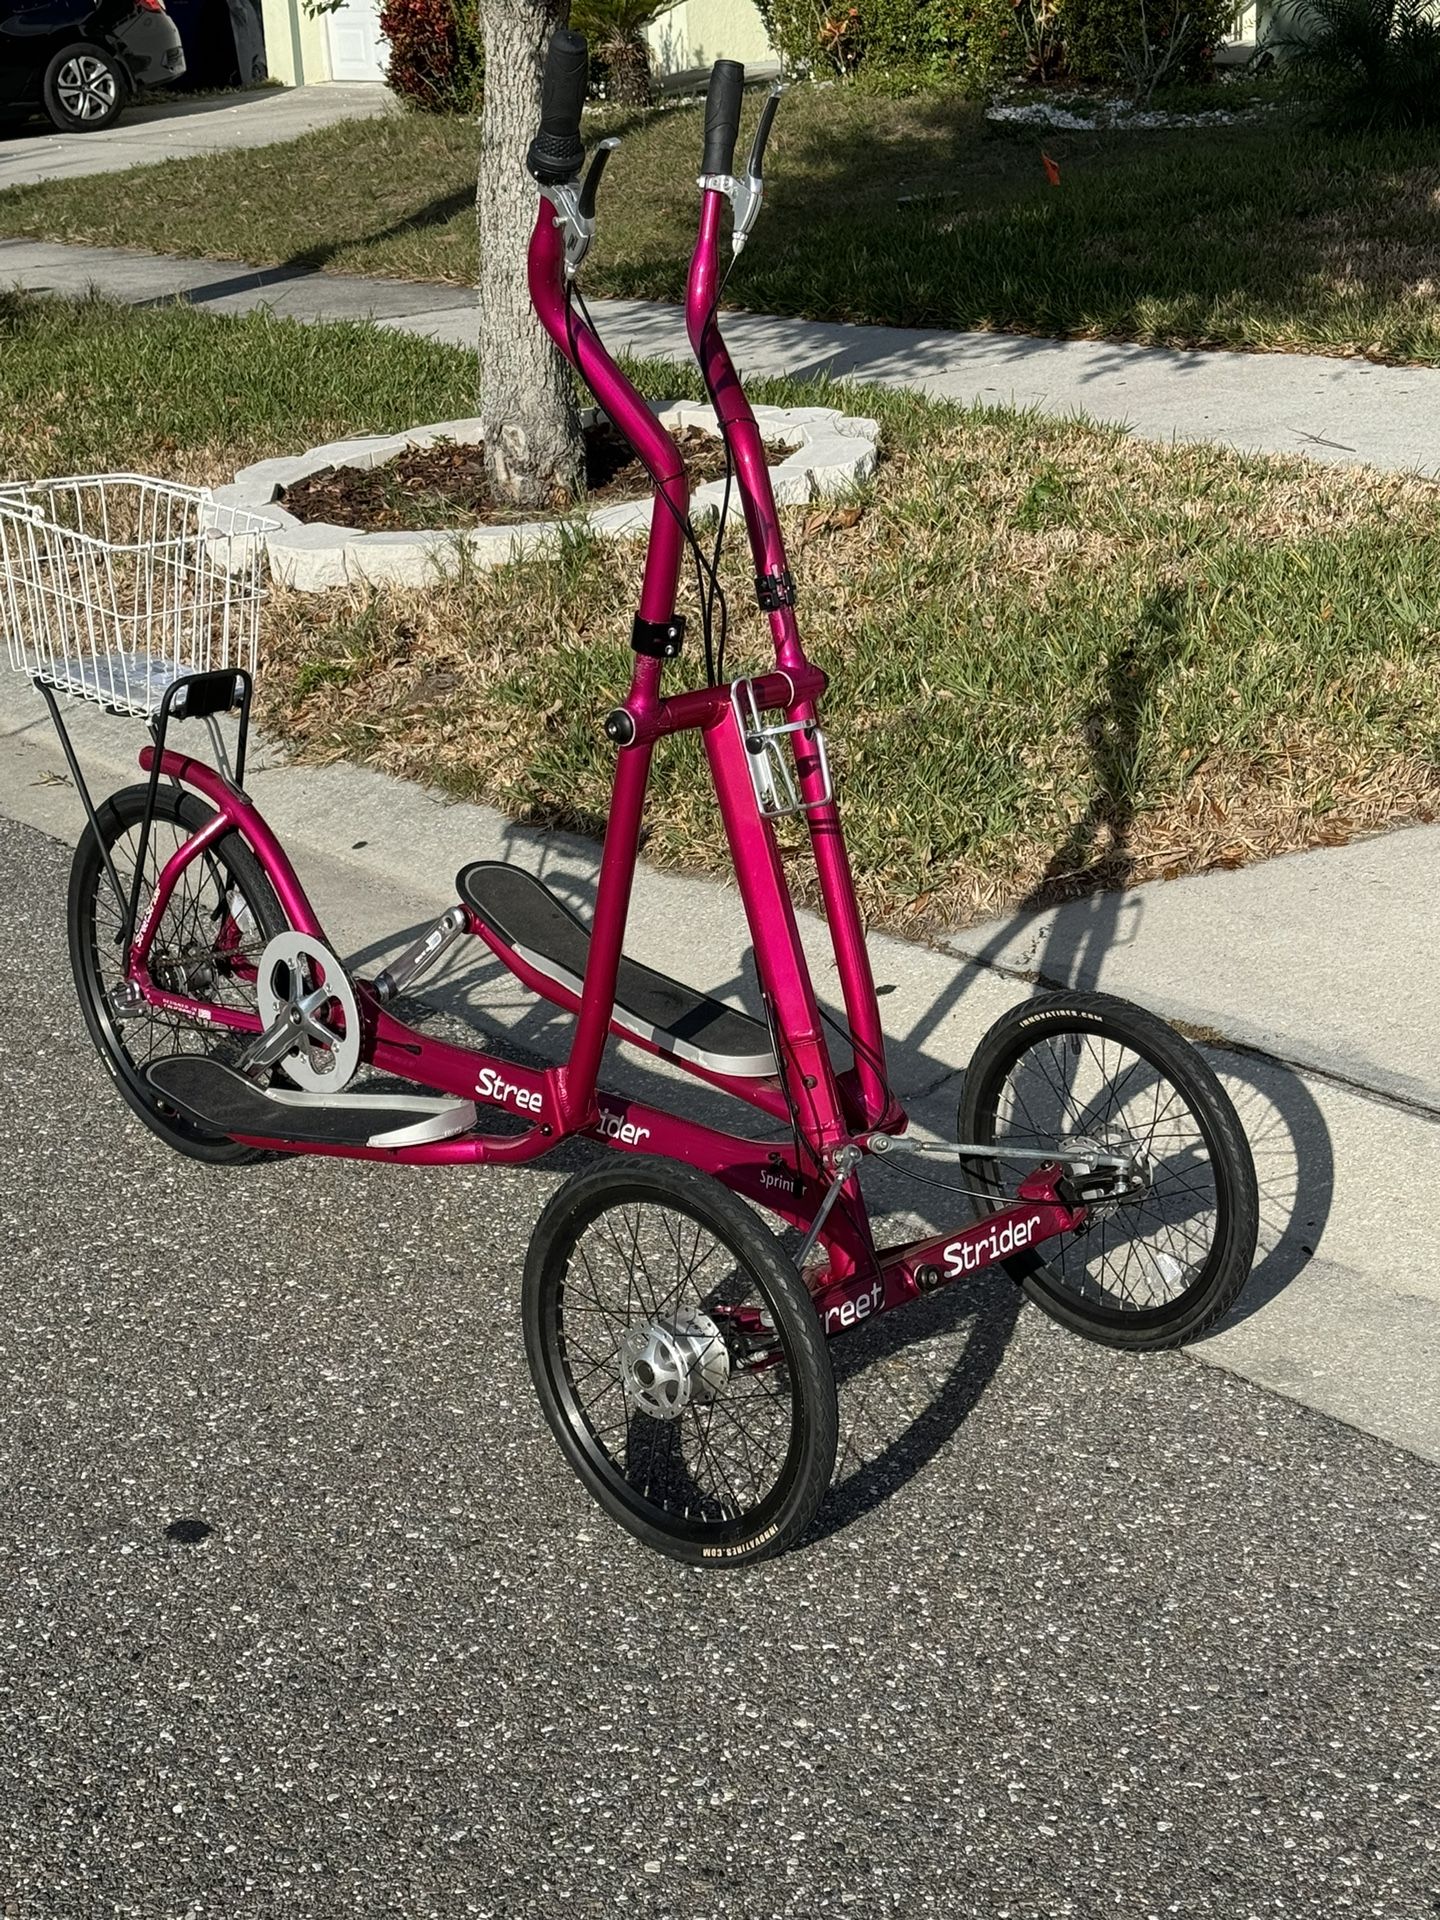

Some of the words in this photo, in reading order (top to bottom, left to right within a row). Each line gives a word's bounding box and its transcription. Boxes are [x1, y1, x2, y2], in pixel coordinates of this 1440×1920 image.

[475, 1068, 543, 1113] Stree
[596, 1108, 650, 1146] ider
[820, 1282, 886, 1335] reet
[943, 1216, 1041, 1279] Strider
[703, 1523, 779, 1558] INNOVATIRES.COM
